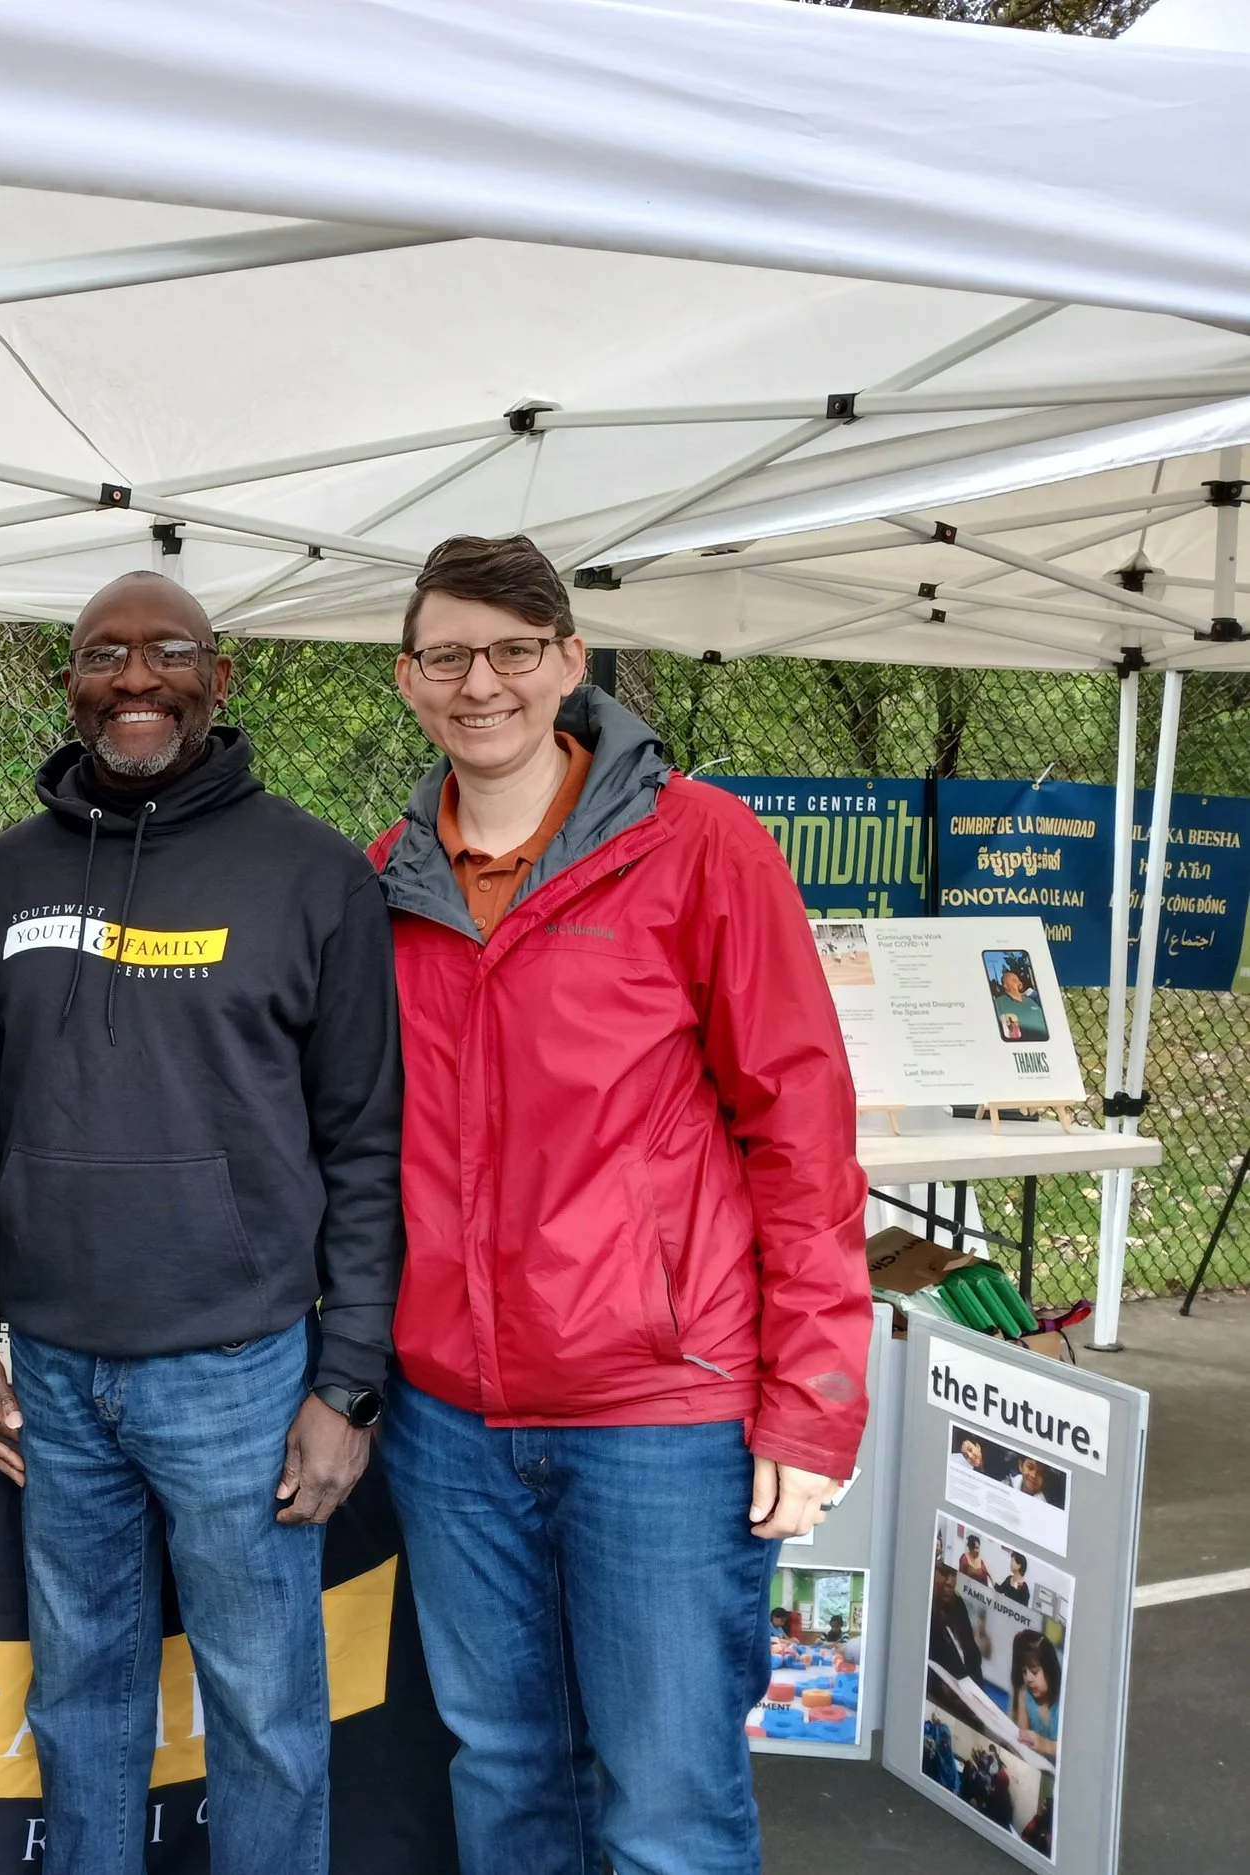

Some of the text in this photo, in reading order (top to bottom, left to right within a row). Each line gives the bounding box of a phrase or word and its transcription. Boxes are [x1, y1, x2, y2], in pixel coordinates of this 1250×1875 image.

[808, 796, 877, 812] CENTER
[950, 815, 1096, 839] CUMBRE DE LA COMUNIDAD
[1188, 828, 1241, 848] BEESHA
[941, 887, 1039, 907] FONOTAGA
[1040, 889, 1049, 906] O
[1050, 889, 1060, 906] LE
[12, 904, 105, 924] SOUTHWEST
[17, 925, 208, 956] YOUTH & FAMILY
[1012, 1052, 1050, 1073] THANKS
[963, 1584, 1031, 1627] FAMILY SUPPORT
